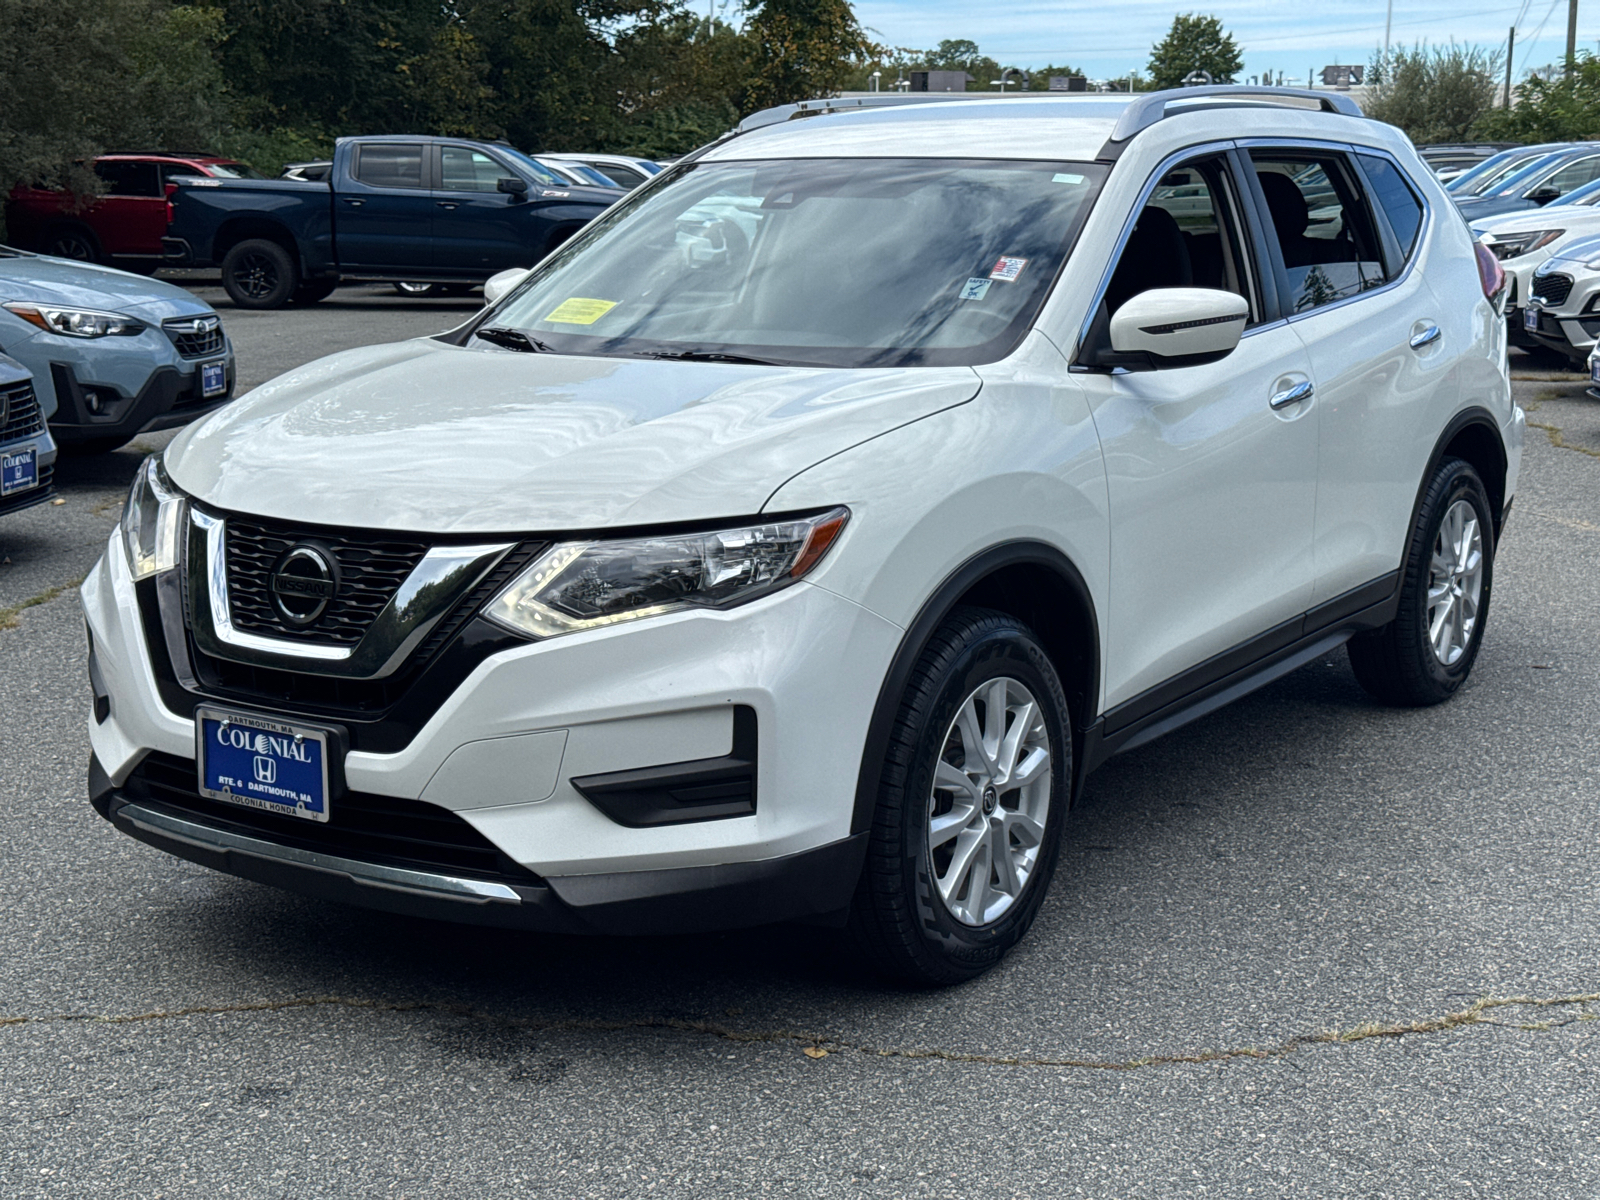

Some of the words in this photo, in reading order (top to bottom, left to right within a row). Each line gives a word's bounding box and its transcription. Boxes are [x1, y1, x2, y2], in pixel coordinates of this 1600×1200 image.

[275, 578, 325, 595] NISSAN
[228, 715, 279, 732] DARTMOUTH,
[281, 724, 293, 734] MA
[217, 725, 312, 763] COLONIAL
[218, 776, 236, 787] RTE.
[237, 780, 243, 788] 6
[248, 782, 298, 801] DARTMOUTH,
[300, 794, 312, 803] MA
[230, 795, 268, 809] COLONIAL
[269, 802, 297, 815] HONDA
